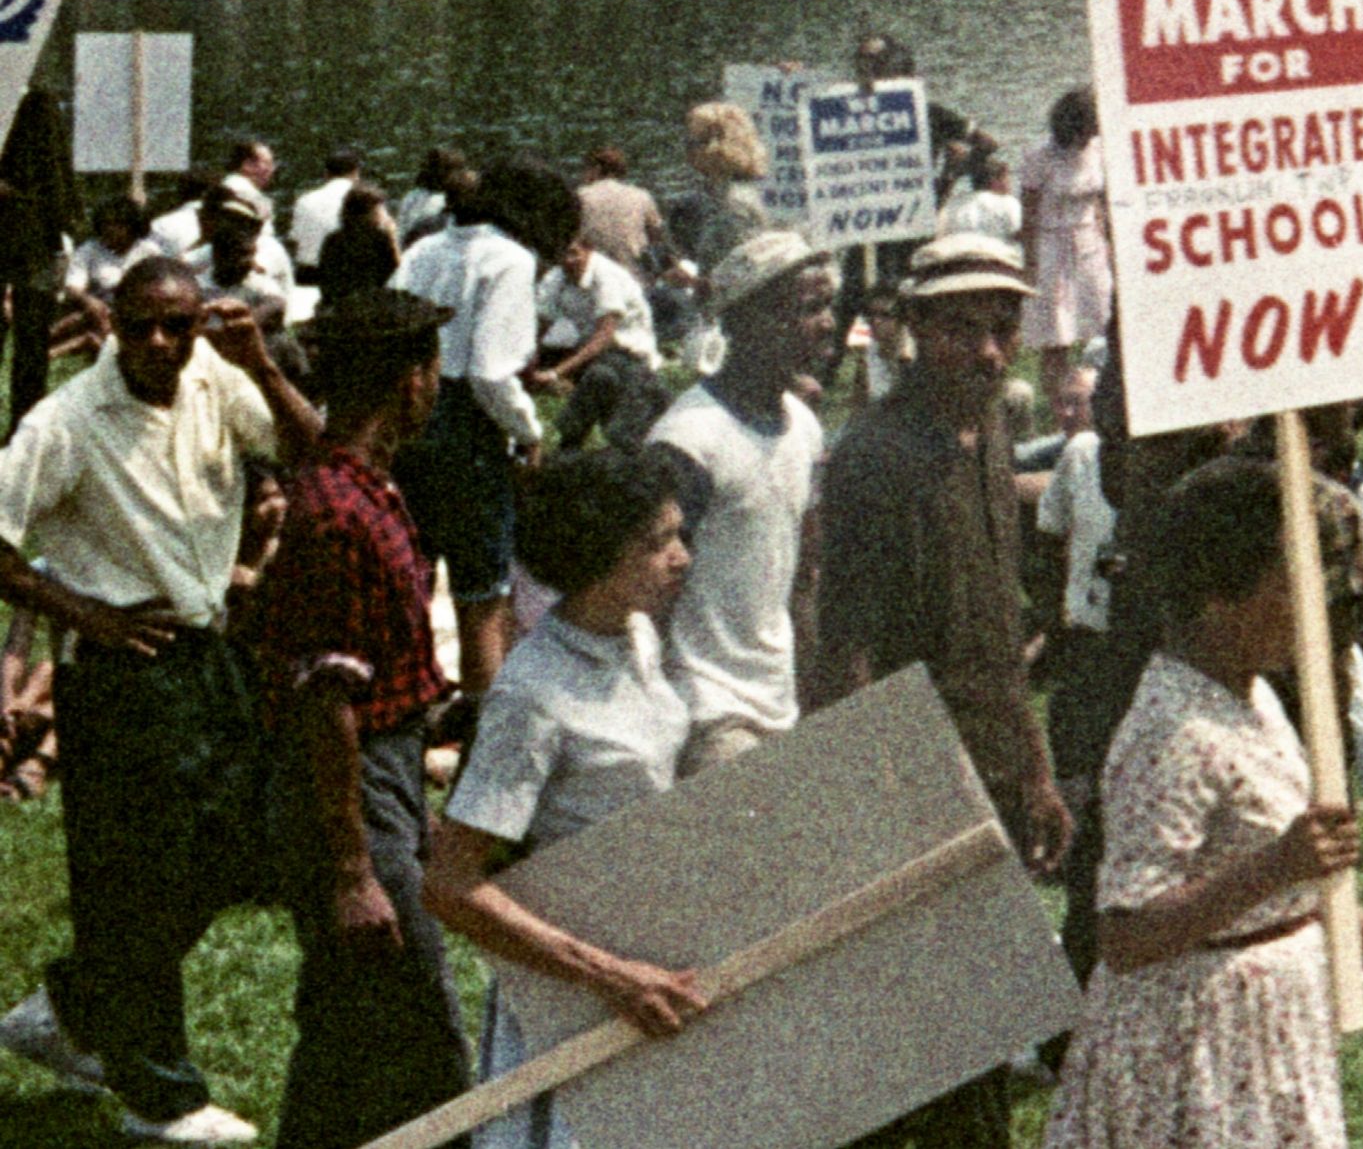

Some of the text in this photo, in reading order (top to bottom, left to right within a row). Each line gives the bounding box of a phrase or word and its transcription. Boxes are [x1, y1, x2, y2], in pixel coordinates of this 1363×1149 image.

[1221, 49, 1312, 85] FOR
[820, 111, 911, 138] MARCH
[828, 197, 920, 232] NOW!
